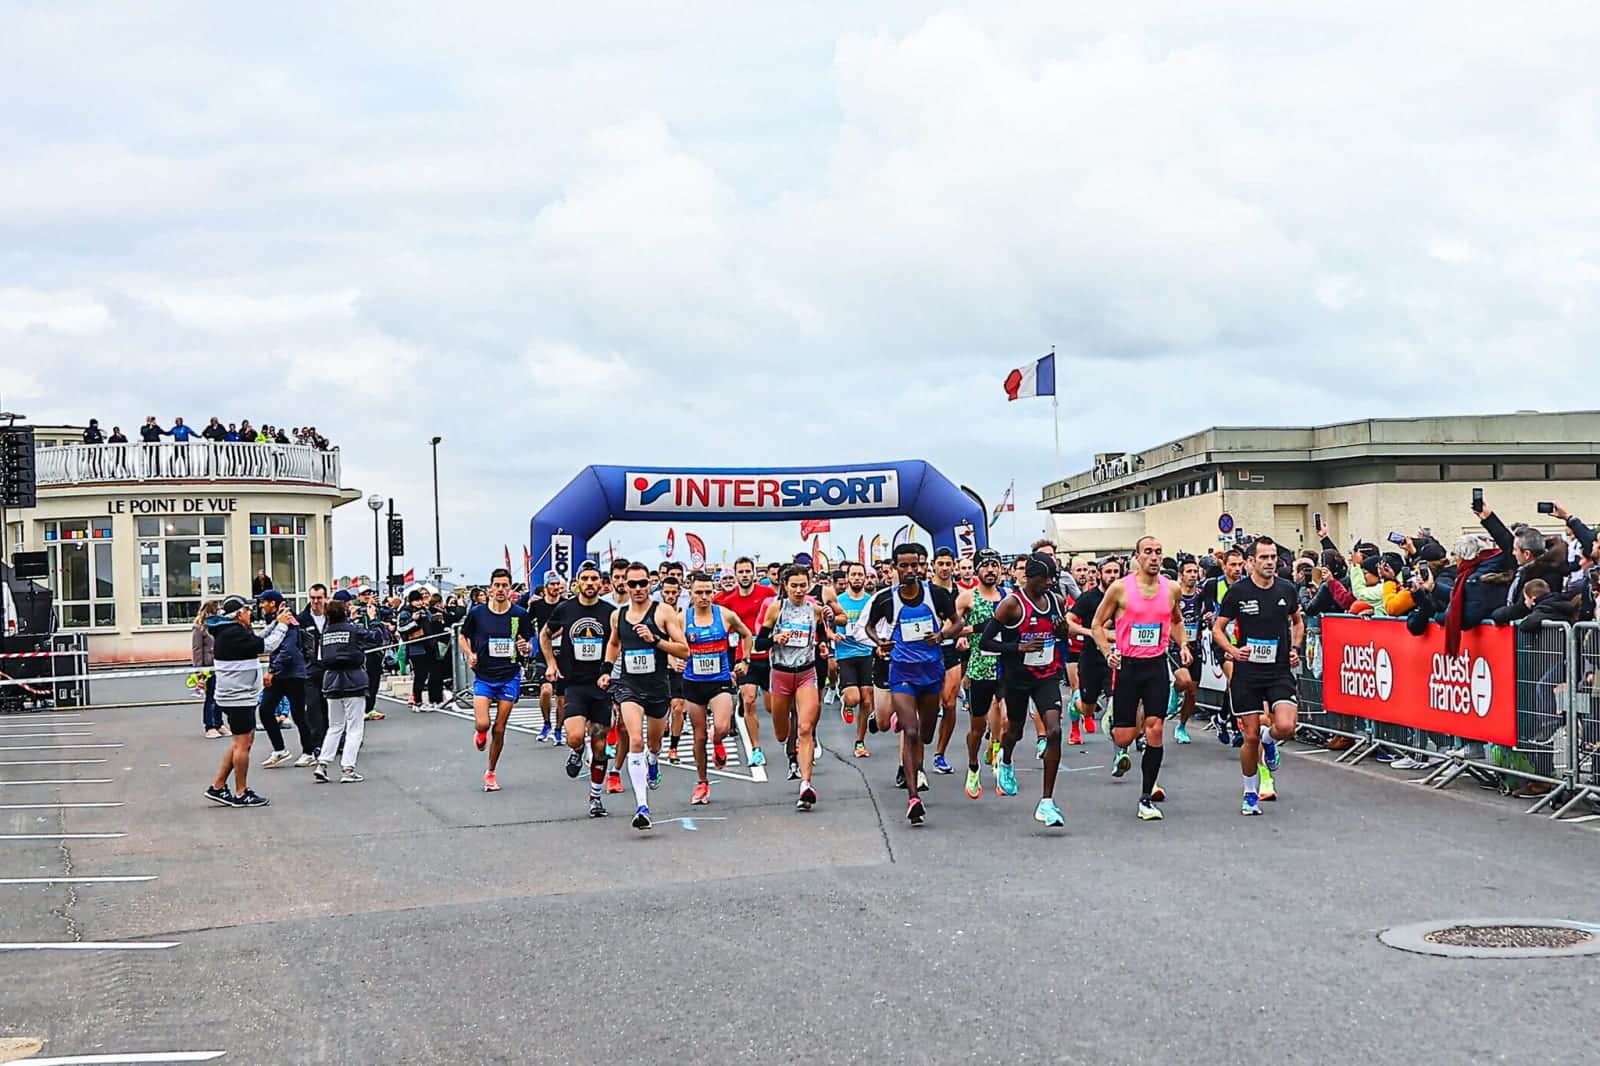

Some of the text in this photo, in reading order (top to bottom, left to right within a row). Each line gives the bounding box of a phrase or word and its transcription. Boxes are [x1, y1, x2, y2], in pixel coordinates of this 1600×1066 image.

[674, 475, 886, 508] INTERSPORT
[108, 498, 237, 514] LE POINT DE VUE
[914, 623, 920, 633] 3
[1138, 629, 1155, 639] 1075
[582, 643, 597, 653] 830
[1253, 645, 1272, 655] 1406
[633, 655, 647, 665] 470
[1344, 641, 1375, 671] ouest
[700, 659, 714, 668] 1104
[1432, 649, 1471, 683] ouest
[1340, 662, 1376, 698] france
[1430, 674, 1472, 714] france
